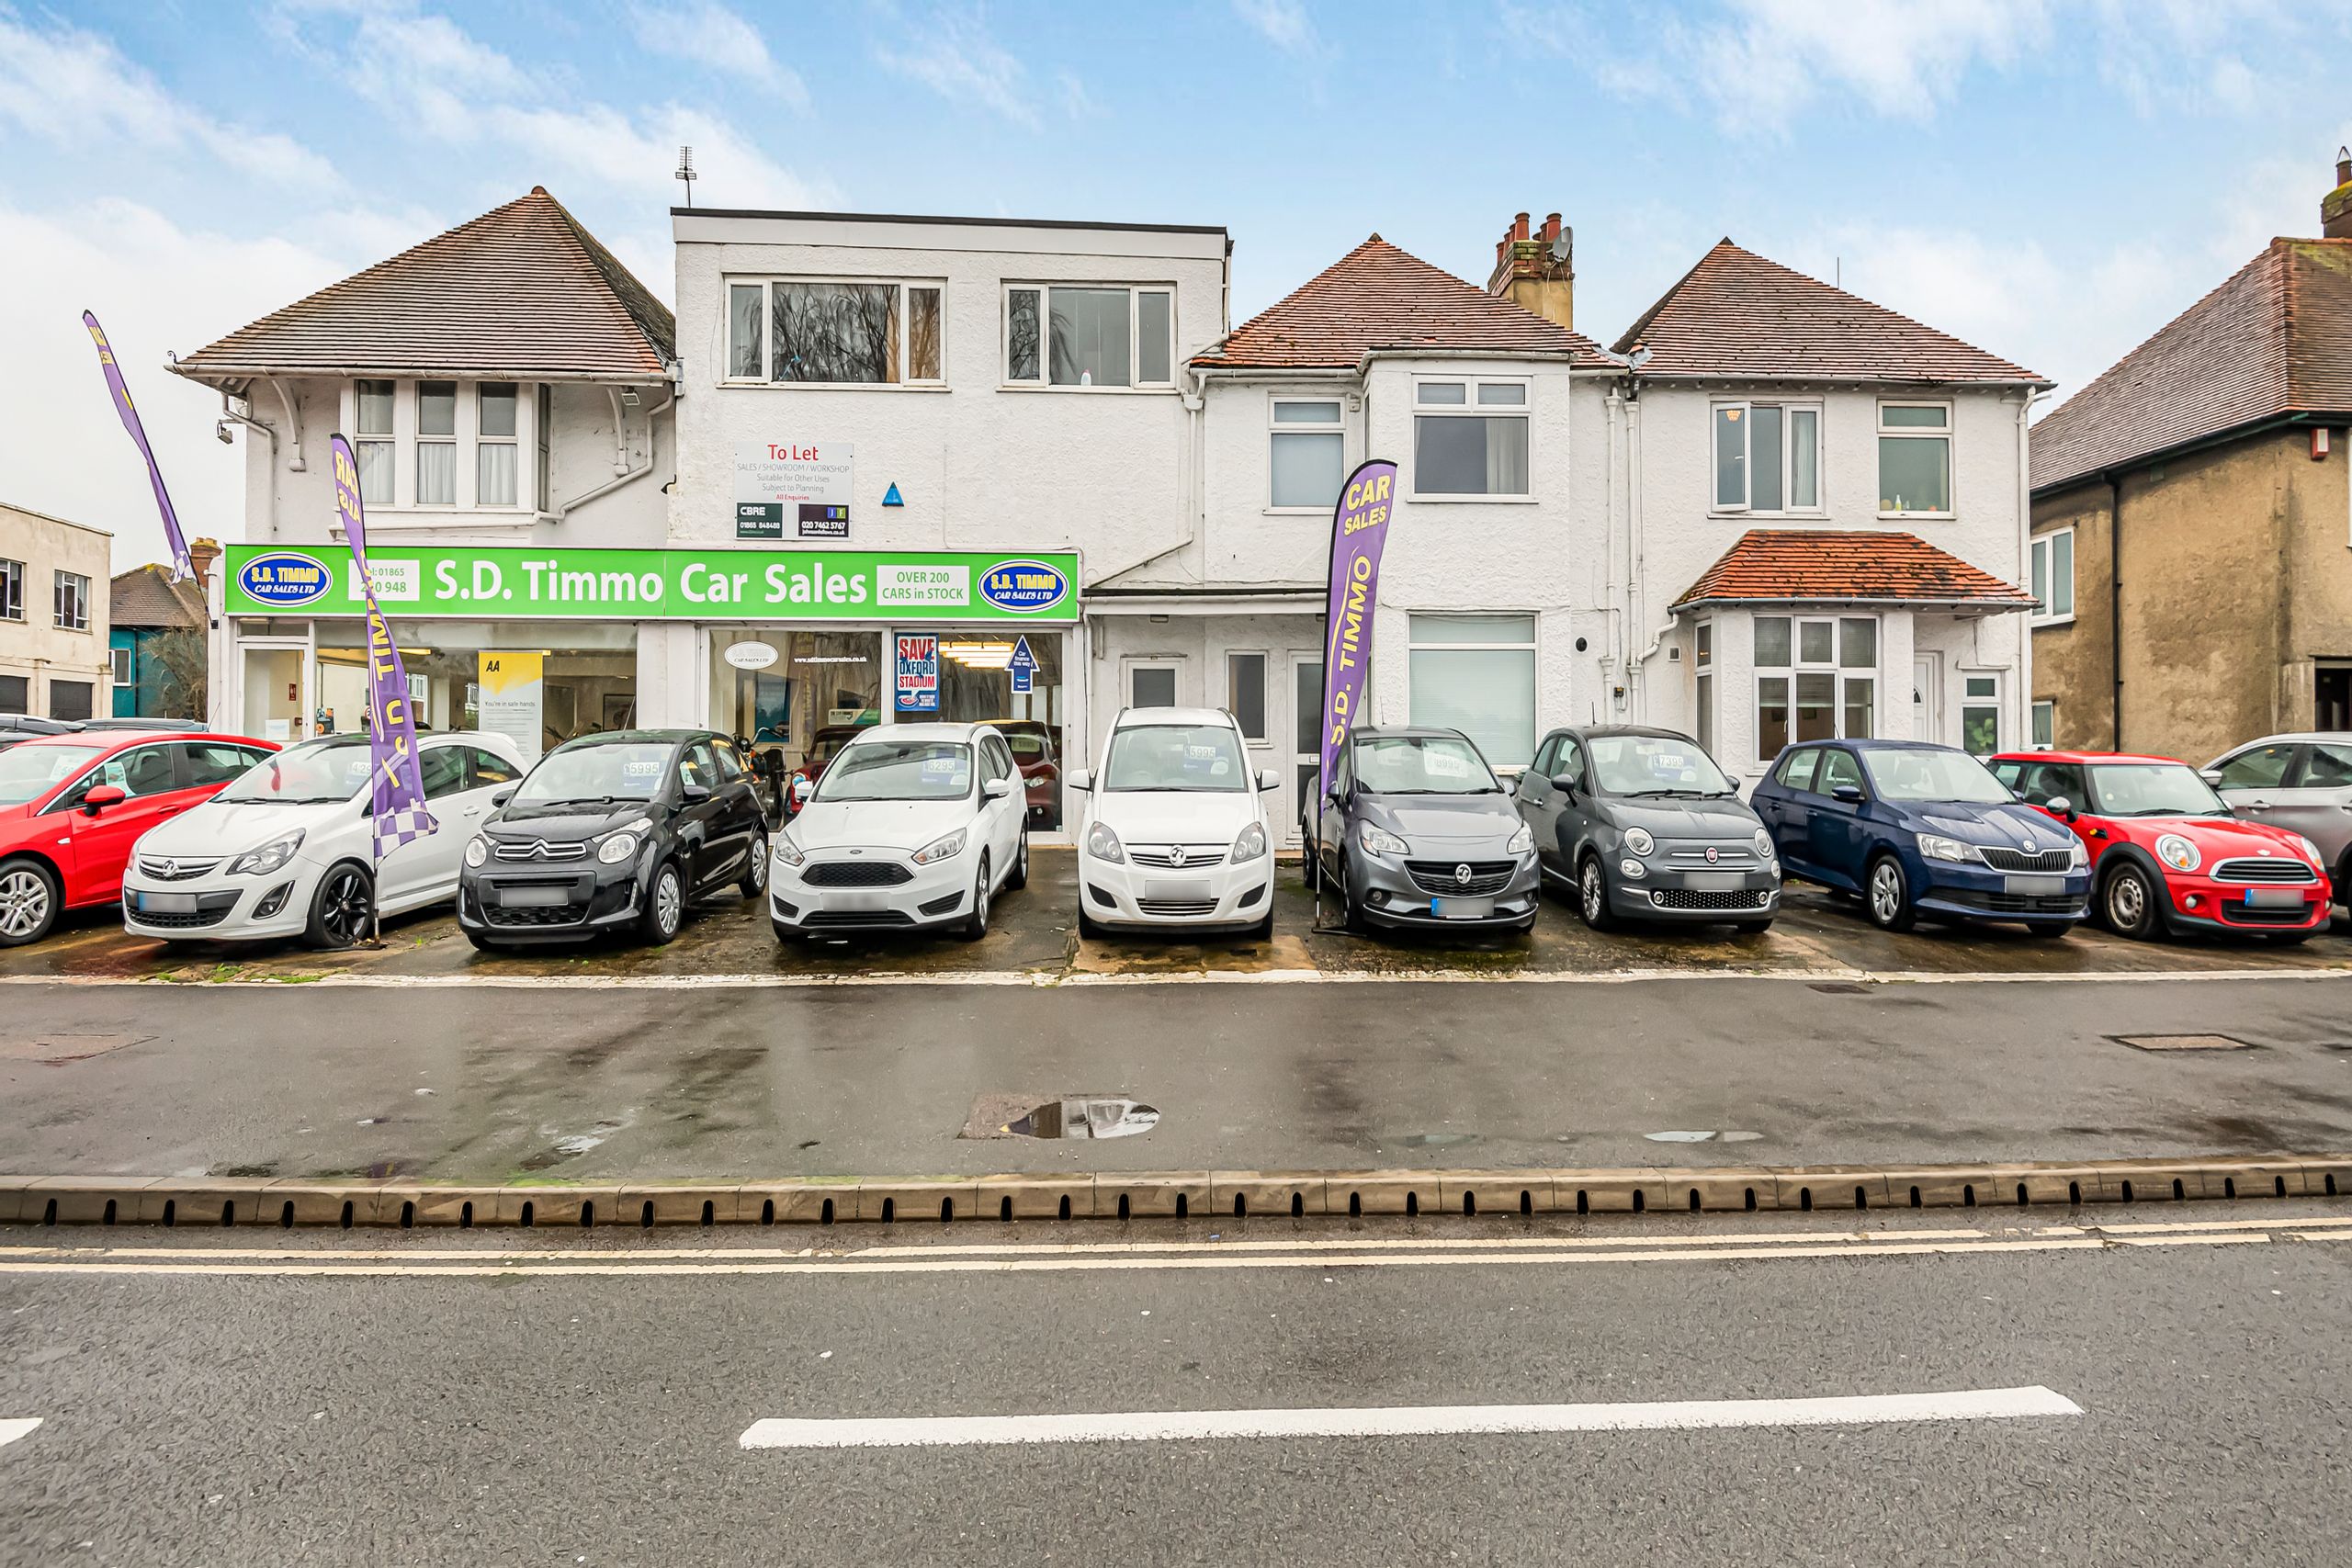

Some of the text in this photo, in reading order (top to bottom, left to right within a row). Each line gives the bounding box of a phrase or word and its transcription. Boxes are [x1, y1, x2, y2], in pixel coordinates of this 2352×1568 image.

[767, 445, 819, 461] To Let
[737, 463, 757, 471] SALES
[763, 463, 805, 472] SHOWROOM
[809, 465, 850, 473] WORKSHOP
[757, 473, 830, 483] Suitable for Other Uses
[762, 483, 824, 494] Subject to Planning
[1346, 474, 1391, 511] CAR
[740, 506, 766, 516] CBRE
[801, 521, 845, 530] 020 7462 5767
[1343, 505, 1387, 536] SALES
[251, 566, 320, 583] S.D. TIMMO
[379, 568, 405, 577] 01865
[897, 571, 950, 583] OVER 200
[360, 581, 406, 592] 20 948
[435, 559, 867, 604] S.D. Timmo Car Sales
[990, 573, 1057, 590] S.D. TIMMO
[254, 584, 316, 594] CAR SALES LTD
[882, 587, 964, 600] CARS in STOCK
[994, 591, 1053, 601] CAR SALES LTD
[899, 638, 935, 660] SAVE
[1329, 555, 1372, 747] S.D. TIMMO
[485, 660, 500, 672] AA
[899, 660, 935, 675] OXFORD
[899, 675, 935, 688] STADIUM
